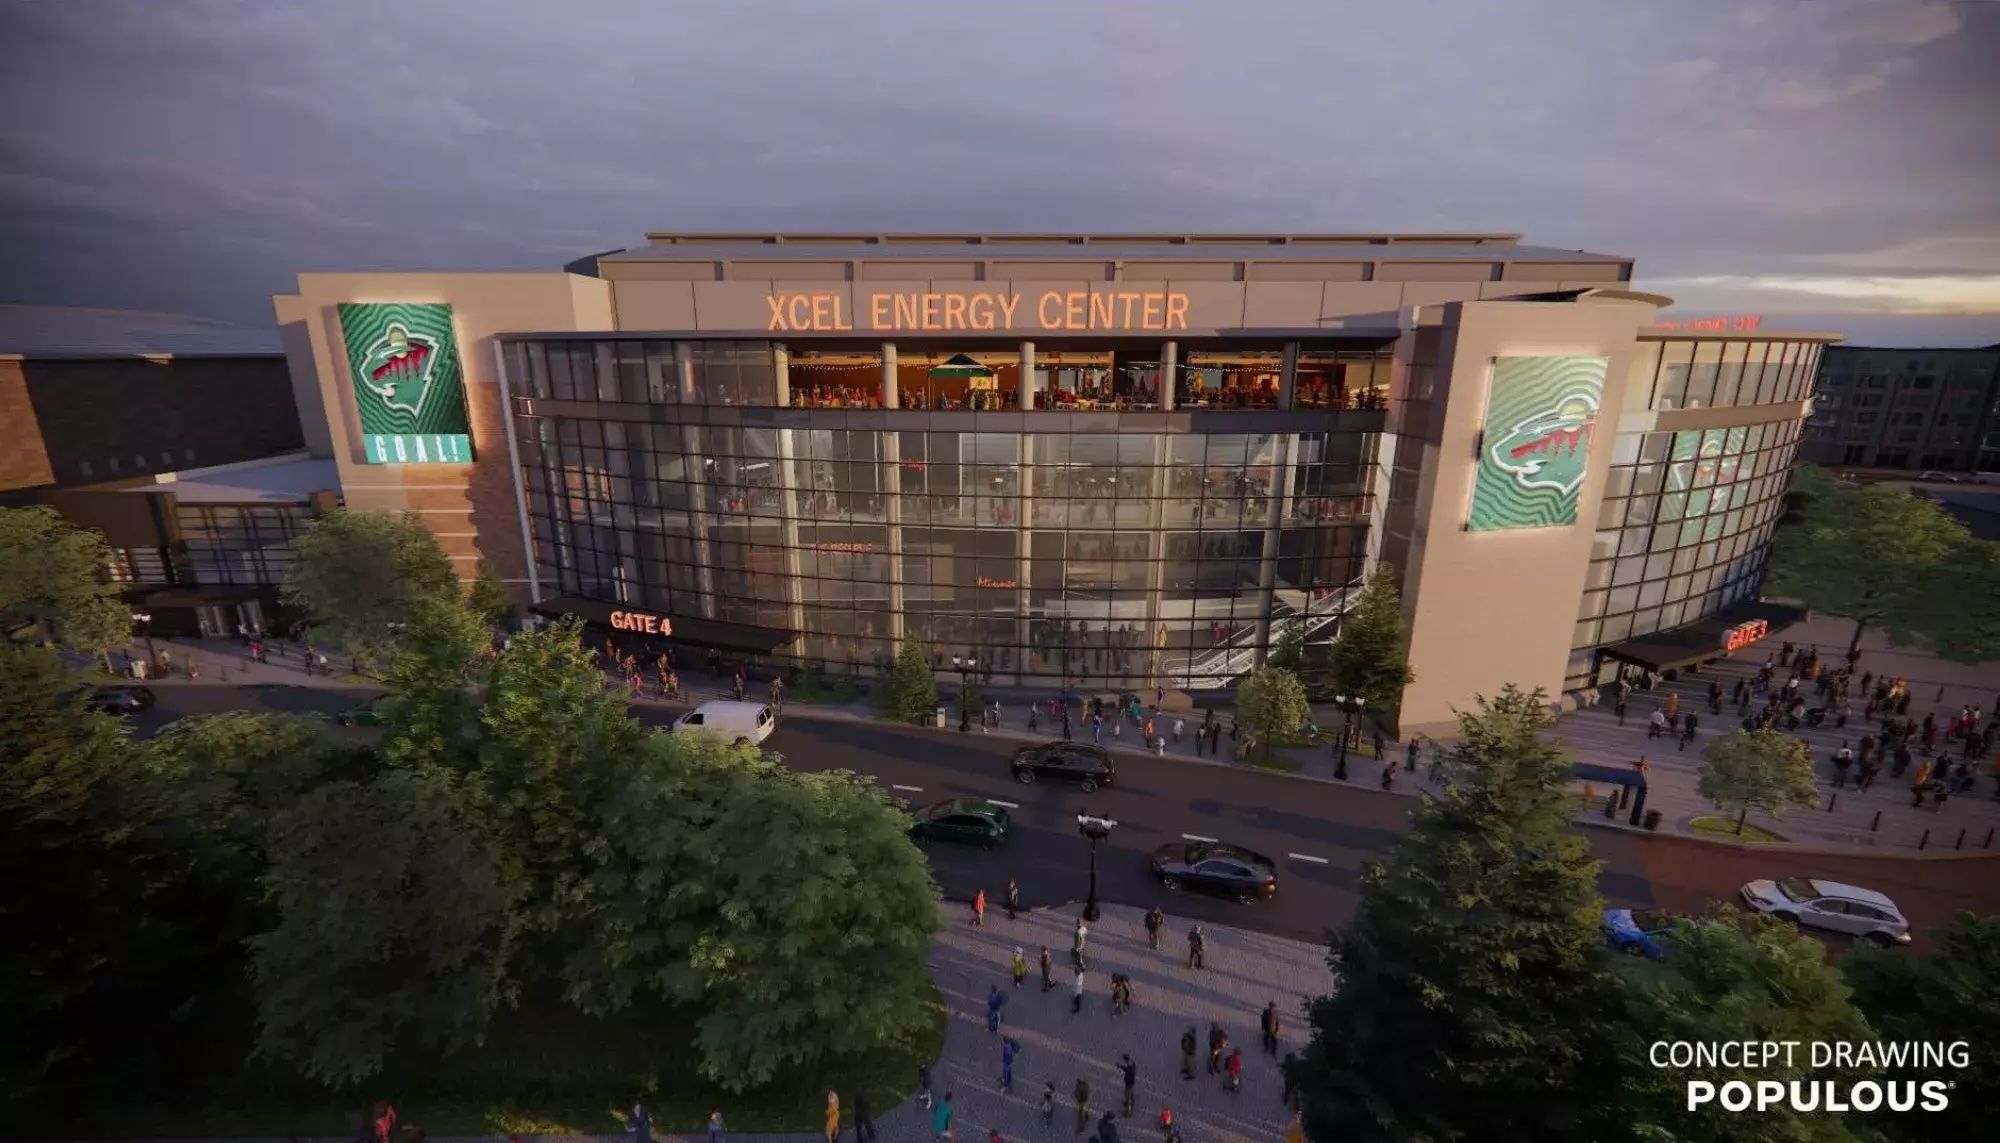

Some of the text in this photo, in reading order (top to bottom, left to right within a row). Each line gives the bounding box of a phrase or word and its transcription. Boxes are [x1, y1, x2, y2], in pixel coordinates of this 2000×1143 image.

[766, 291, 1190, 331] XCEL ENERGY CENTER
[375, 435, 460, 463] GOAL!
[610, 609, 673, 637] GATE 4
[1725, 624, 1757, 650] GATE
